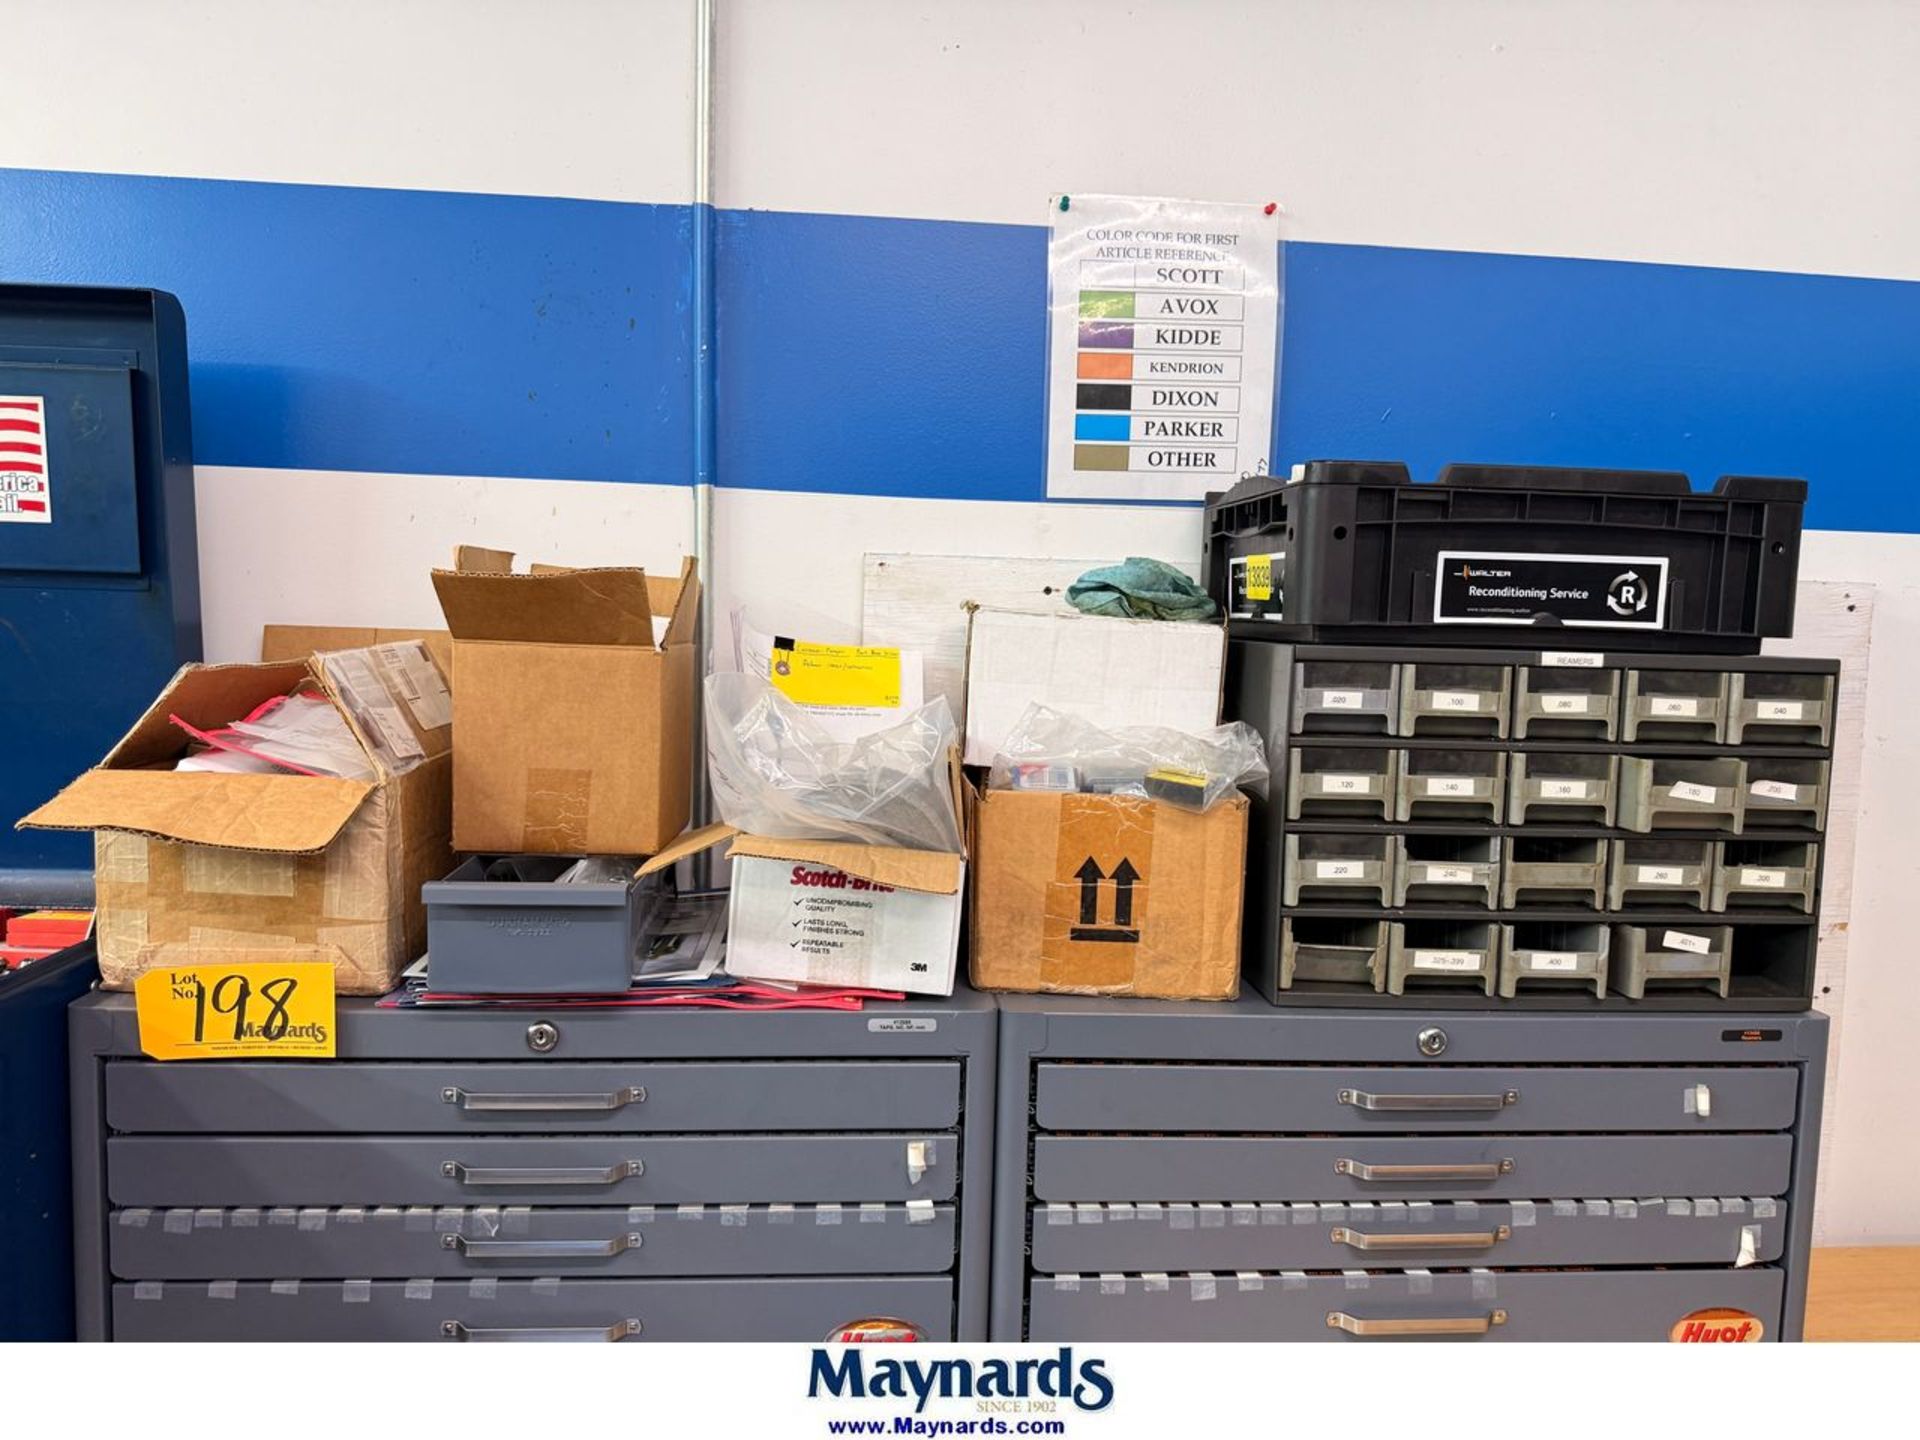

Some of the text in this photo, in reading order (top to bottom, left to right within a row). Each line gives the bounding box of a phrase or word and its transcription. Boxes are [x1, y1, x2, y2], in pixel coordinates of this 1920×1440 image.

[1086, 229, 1240, 246] COLOR CODE FOR FIRST
[1096, 246, 1152, 259] ARTICLE
[1156, 267, 1224, 285] SCOTT
[1160, 299, 1219, 315] AVOX
[1155, 330, 1222, 346] KIDDE
[1149, 362, 1224, 374] KENDRION
[1151, 390, 1219, 407] DIXON
[1143, 421, 1224, 438] PARKER
[1147, 450, 1217, 468] OTHER
[1469, 585, 1589, 600] Reconditioning Service
[1621, 586, 1635, 603] R
[1556, 657, 1595, 666] REAMERS
[835, 929, 865, 937] STRONG
[910, 962, 928, 972] 3M
[171, 973, 197, 985] Lot
[172, 988, 199, 999] No.
[194, 974, 298, 1042] 198
[1681, 1321, 1752, 1342] Huot
